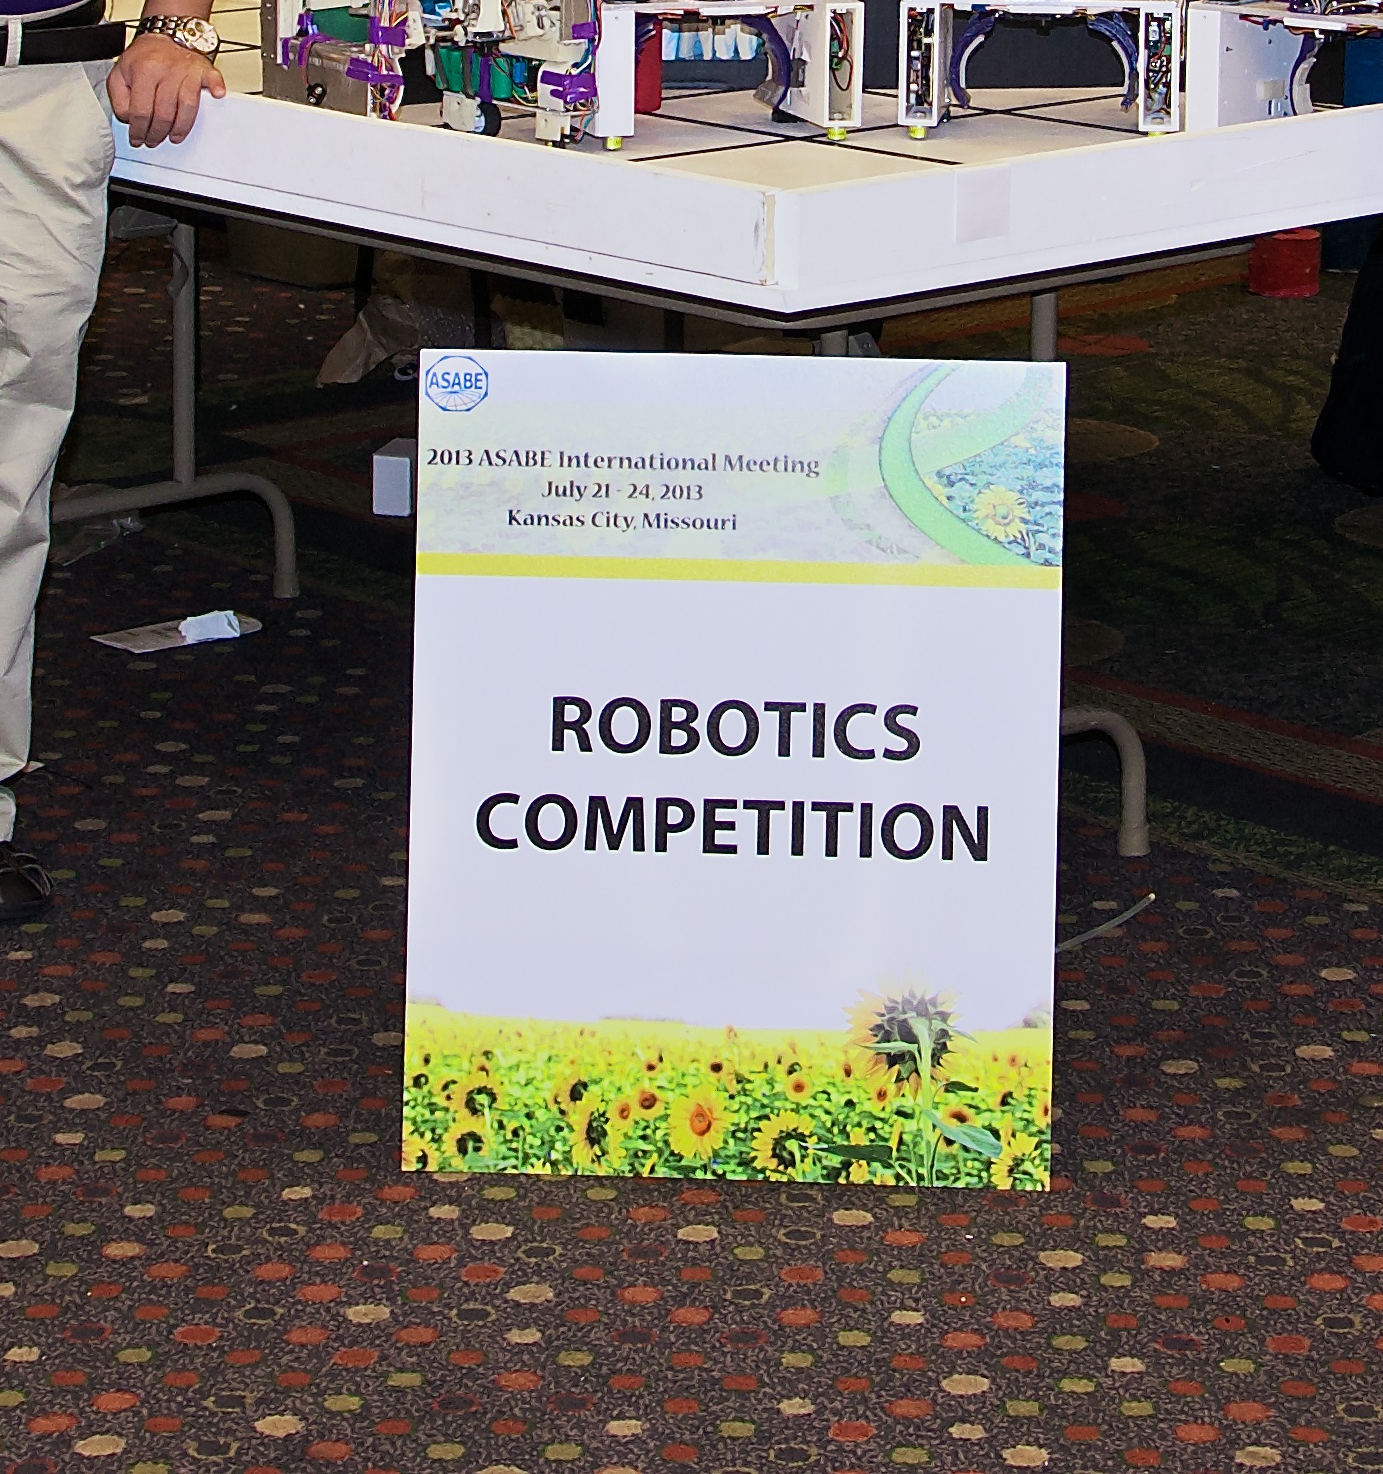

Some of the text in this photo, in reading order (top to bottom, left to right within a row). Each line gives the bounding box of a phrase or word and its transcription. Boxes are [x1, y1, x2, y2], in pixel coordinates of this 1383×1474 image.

[428, 371, 485, 393] ASABE
[426, 448, 821, 479] 2013 ASABE International Meeting
[541, 479, 587, 502] July
[593, 481, 611, 499] 21
[627, 482, 655, 501] 24,
[660, 483, 704, 501] 2013
[507, 509, 737, 534] Kansas City, Missouri
[551, 696, 922, 761] ROBOTICS
[475, 794, 991, 862] COMPETITION
